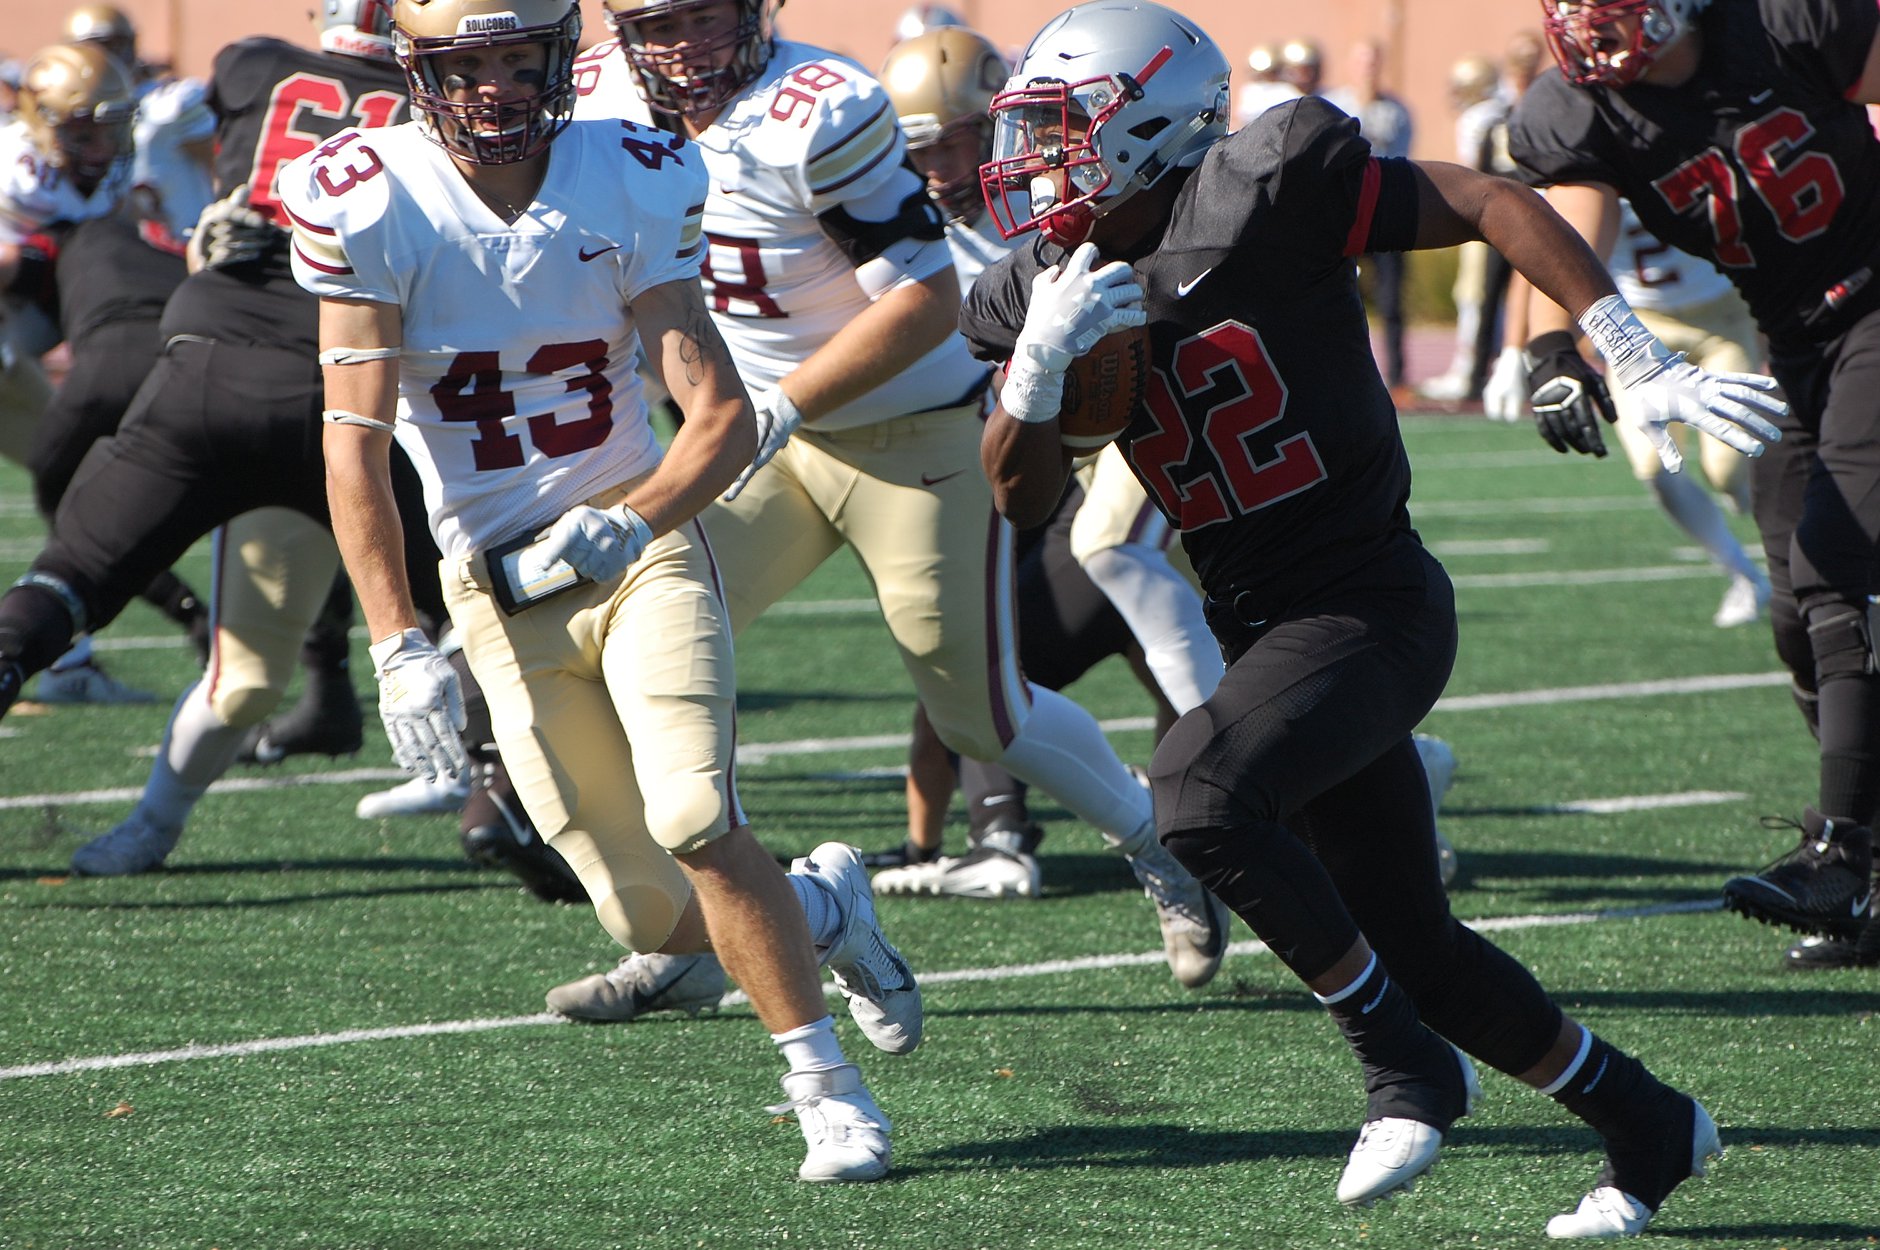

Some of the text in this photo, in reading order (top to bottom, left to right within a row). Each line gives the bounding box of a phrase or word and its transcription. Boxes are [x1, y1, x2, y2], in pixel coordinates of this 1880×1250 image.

[466, 17, 516, 32] ROLLCOBBS
[770, 64, 846, 129] 98
[246, 71, 406, 228] 6
[310, 133, 383, 197] 43
[1651, 106, 1844, 267] 76
[1588, 313, 1634, 367] BLESSED
[430, 338, 614, 472] 43
[1130, 318, 1329, 533] 22
